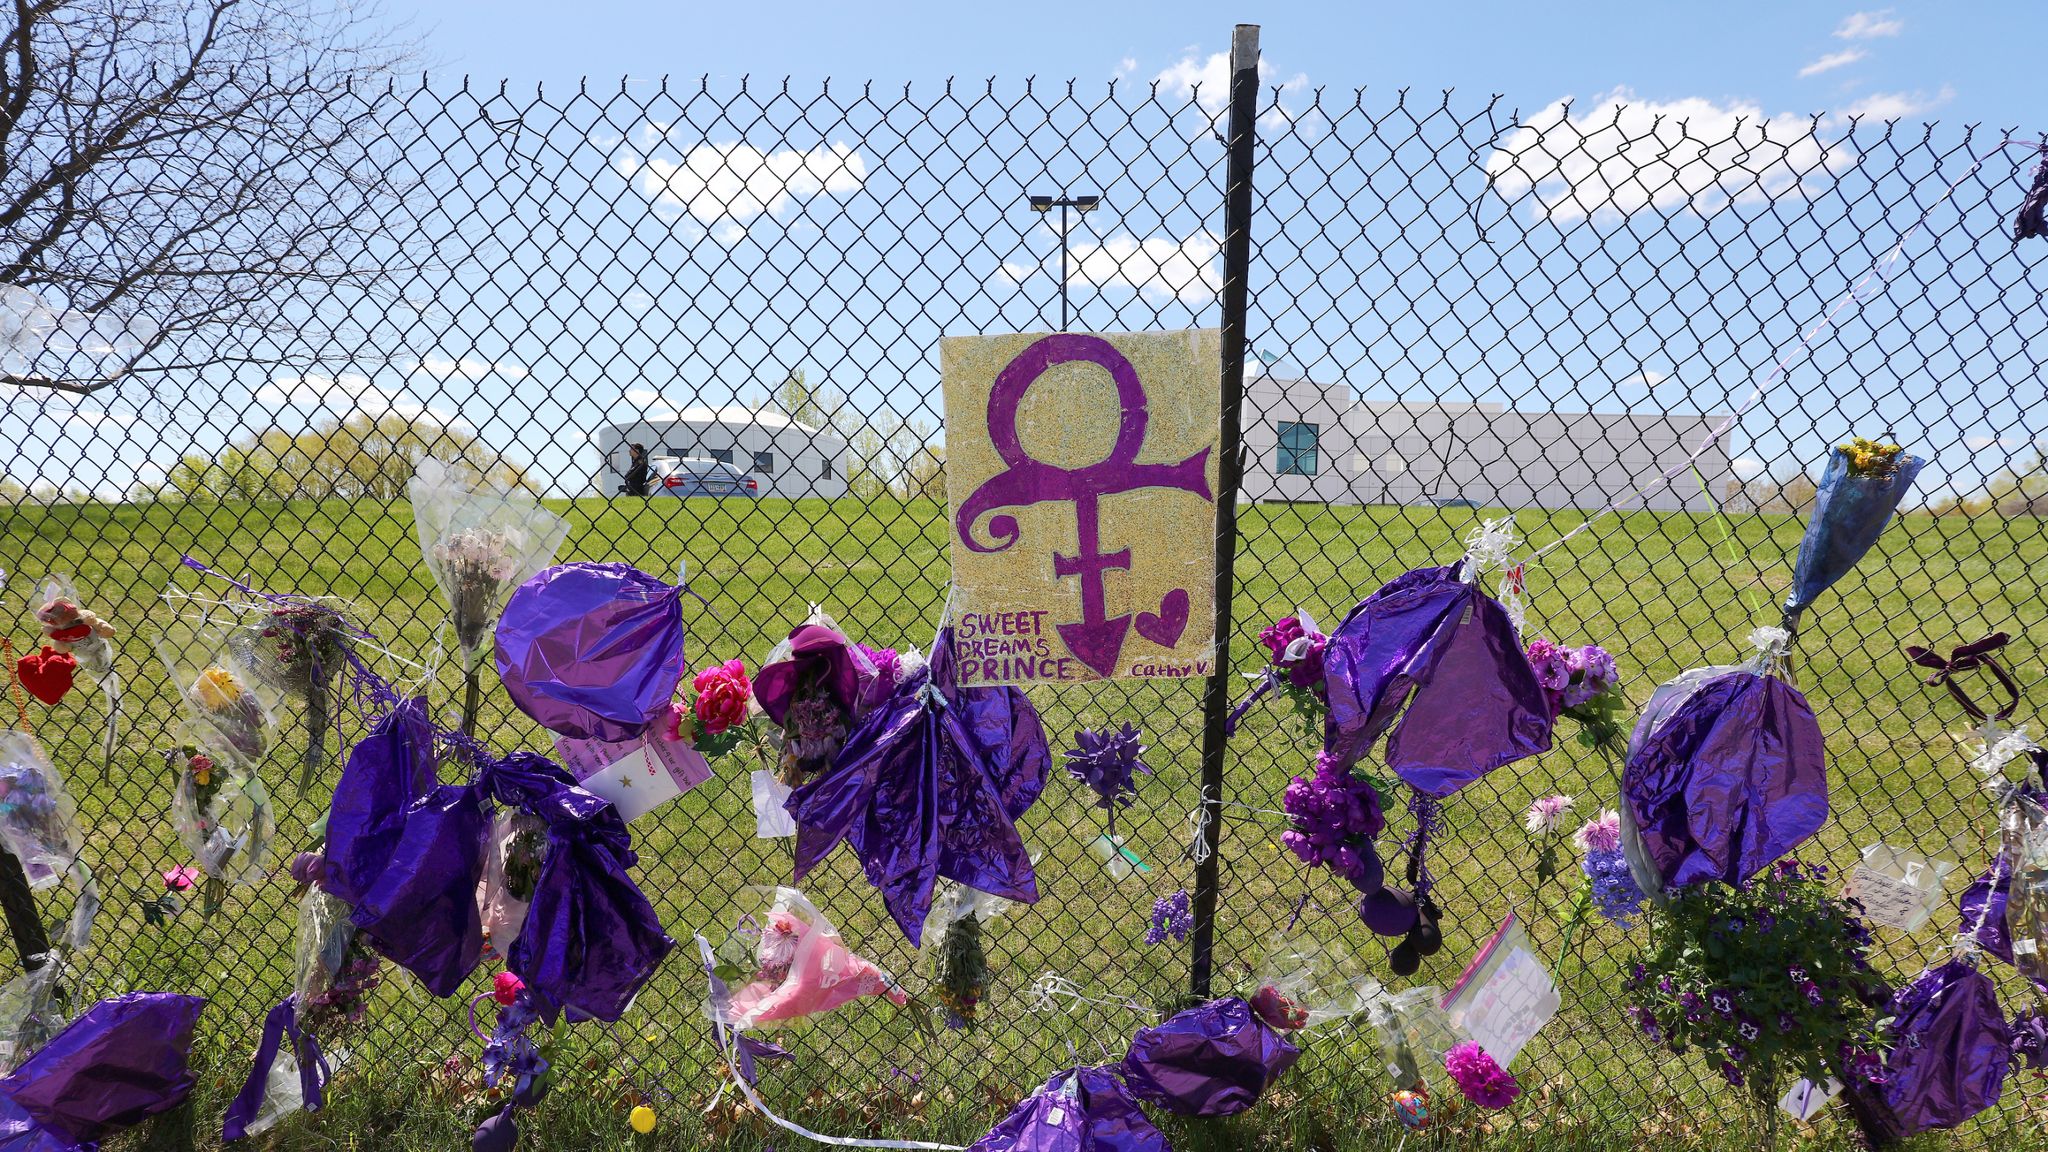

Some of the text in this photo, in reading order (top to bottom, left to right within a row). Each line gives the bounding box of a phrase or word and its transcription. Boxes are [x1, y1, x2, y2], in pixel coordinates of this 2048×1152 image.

[959, 610, 1048, 639] SWEET
[956, 637, 1050, 661] DREAMS
[961, 655, 1075, 685] PRINCE
